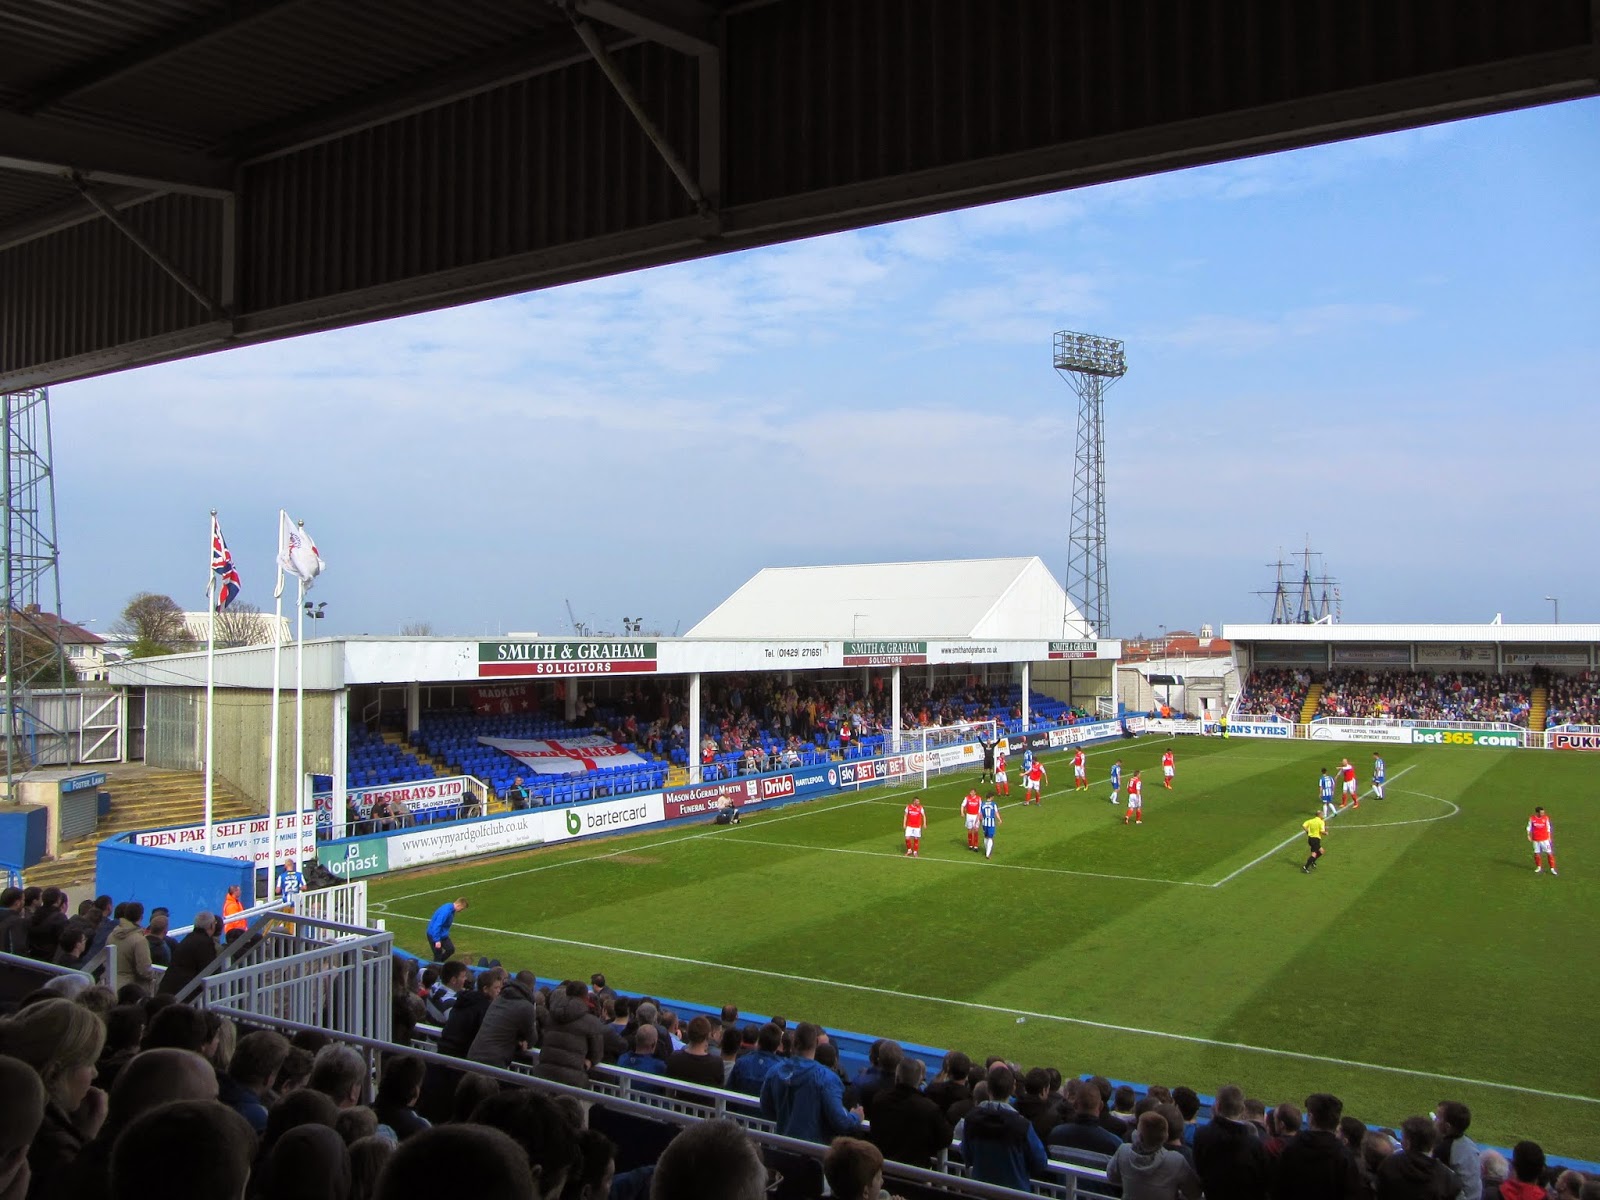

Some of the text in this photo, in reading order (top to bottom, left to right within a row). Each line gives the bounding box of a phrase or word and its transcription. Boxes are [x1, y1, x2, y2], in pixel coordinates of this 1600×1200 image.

[498, 644, 645, 660] SMITH & GRAHAM
[851, 642, 919, 655] SMITH & GRAHAM
[1052, 642, 1094, 650] SMITH & GRAHAM
[765, 648, 822, 658] Tel. (01429) 271651
[868, 656, 903, 664] SOLICITORS
[537, 662, 611, 674] SOLICITORS
[478, 687, 526, 698] MADKATS
[1253, 726, 1287, 736] TYRES
[1413, 729, 1517, 746] bet365.com
[841, 764, 872, 781] sky BET
[764, 776, 792, 795] Drive
[795, 775, 825, 787] HARTLEPOOL
[363, 785, 436, 805] RESPRAYS
[439, 782, 461, 798] LTD
[666, 792, 690, 804] MASON
[690, 790, 696, 800] &
[696, 786, 718, 799] GERALD
[680, 803, 706, 814] FUNERAL
[587, 805, 647, 828] bartercard
[141, 833, 177, 847] EDEN
[180, 829, 206, 843] PAR
[217, 823, 246, 837] SELF
[250, 818, 284, 833] DRIE
[287, 814, 314, 828] HRE
[402, 819, 528, 850] www.wynyardgolfclub.co.uk
[285, 879, 299, 892] 22
